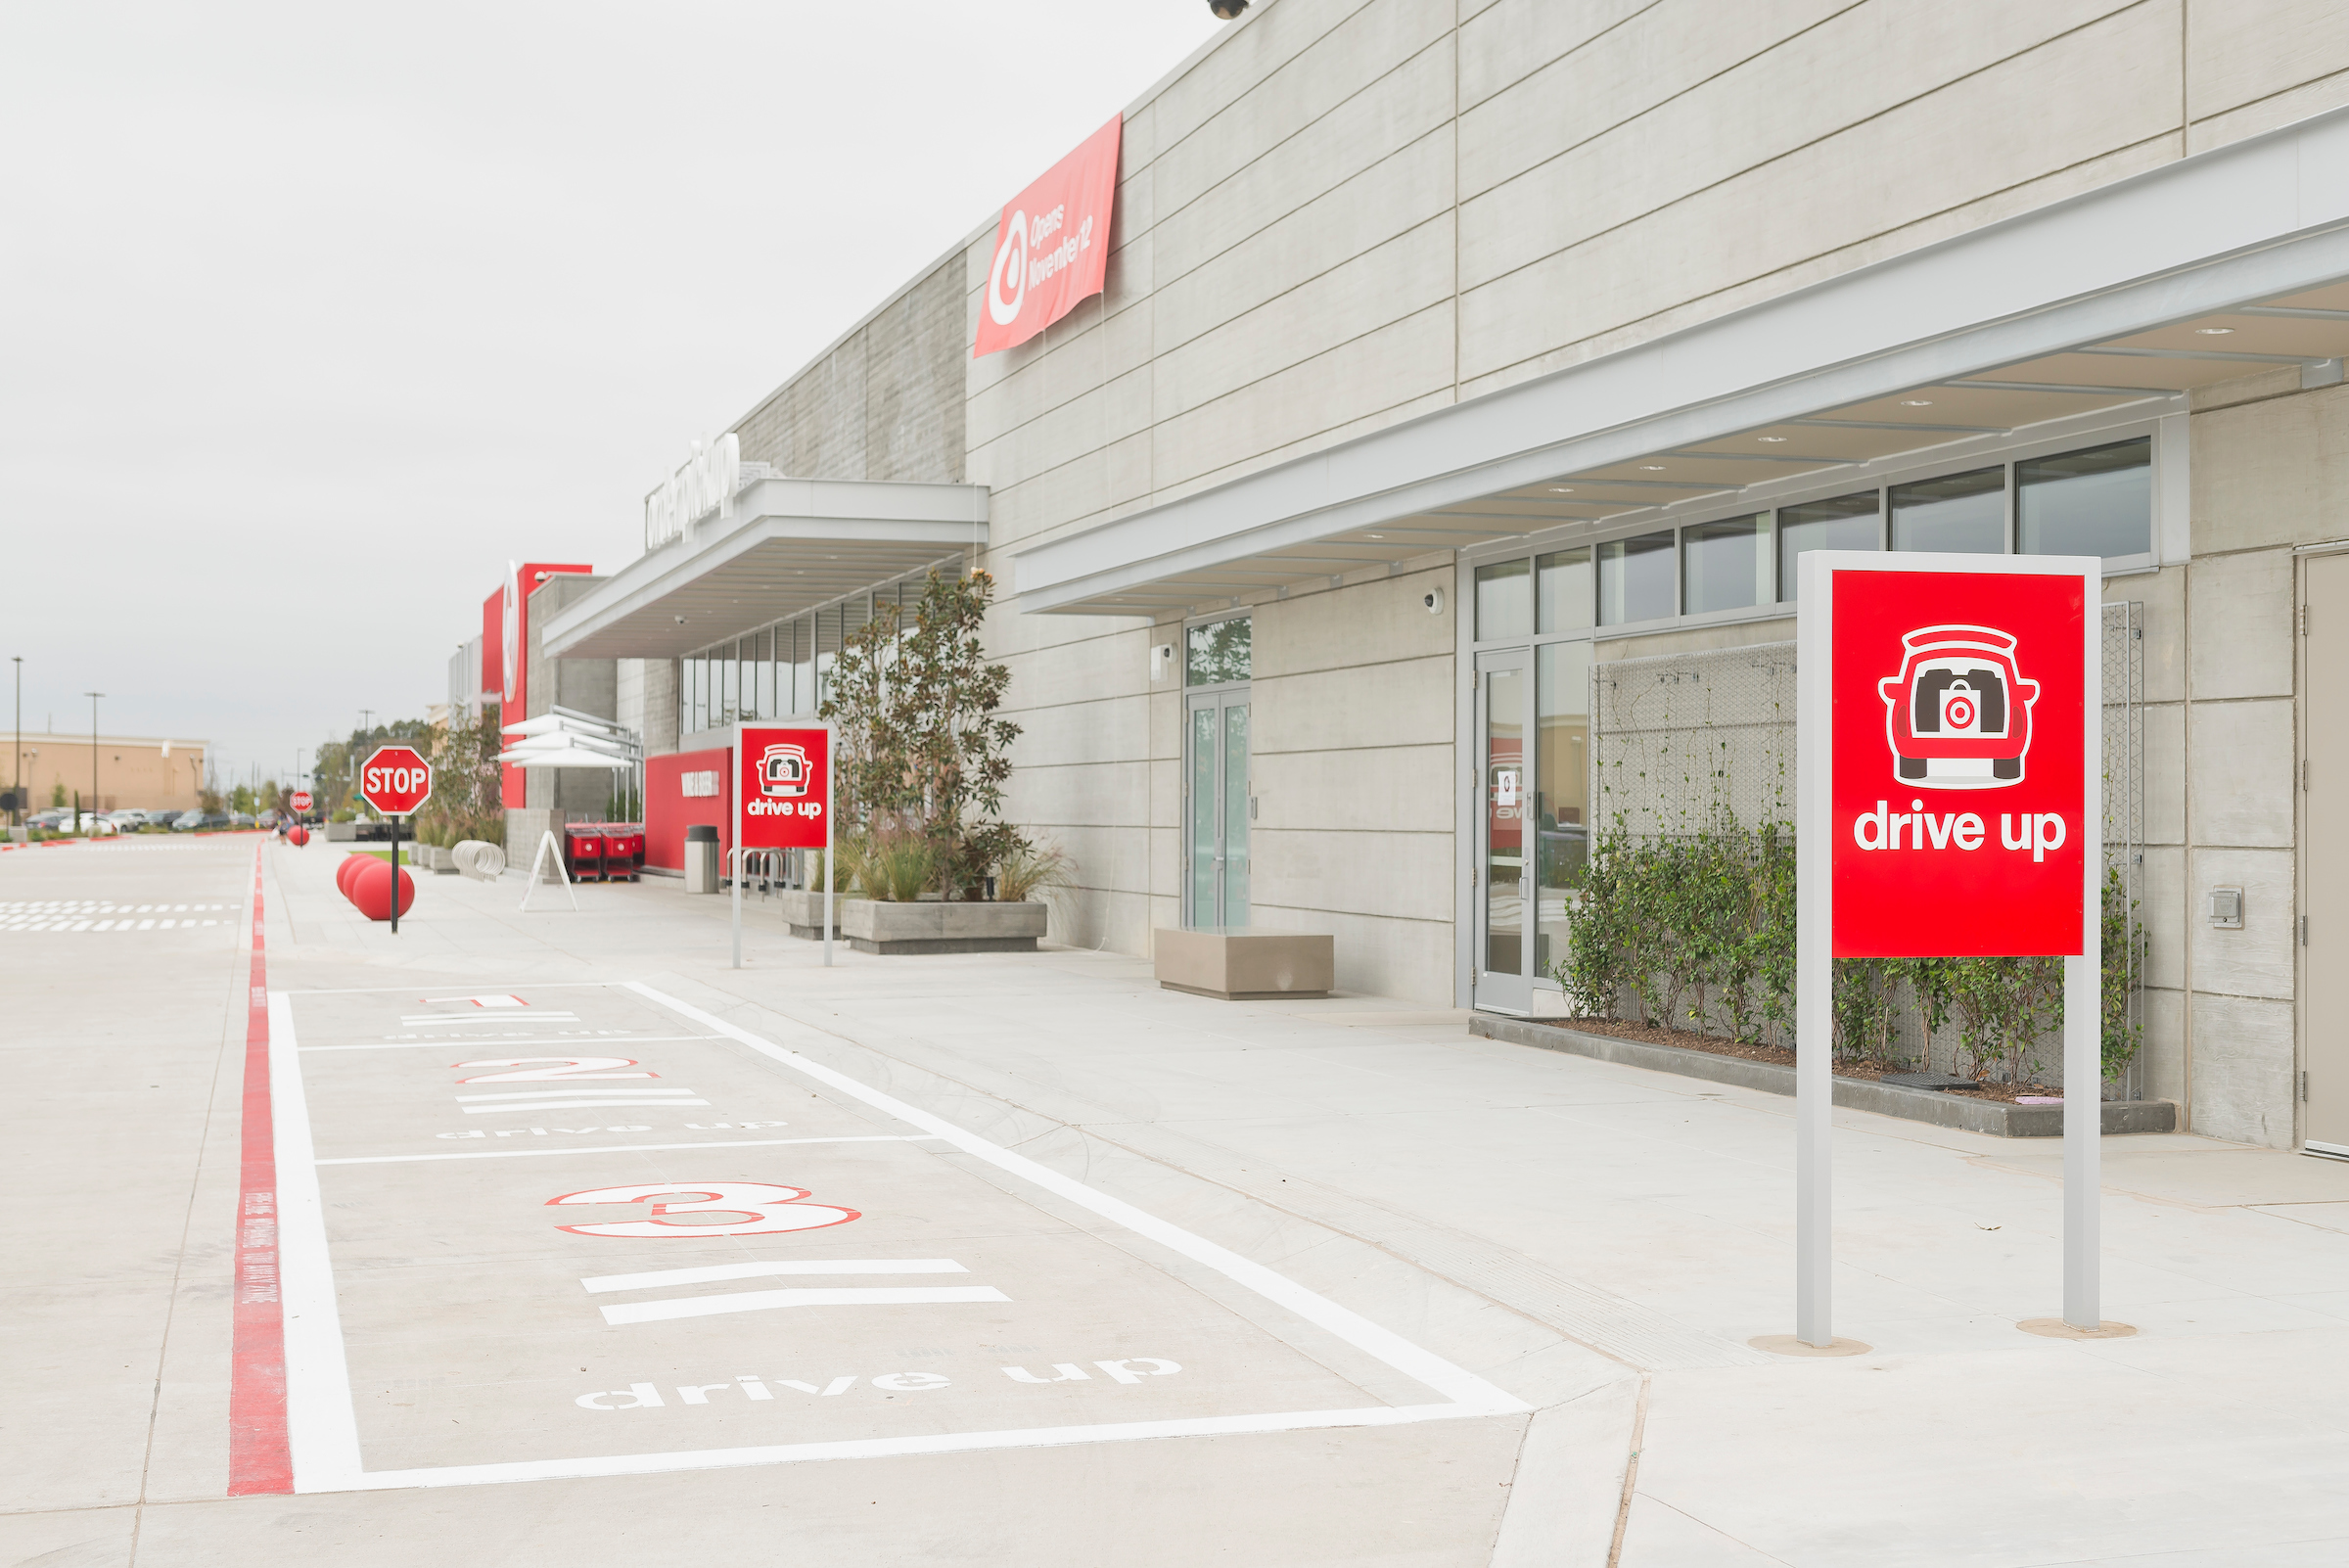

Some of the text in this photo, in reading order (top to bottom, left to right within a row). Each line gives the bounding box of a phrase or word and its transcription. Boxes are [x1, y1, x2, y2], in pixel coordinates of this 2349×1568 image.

[1031, 204, 1064, 250] Opens
[366, 766, 427, 794] STOP
[292, 796, 311, 807] STOP
[747, 798, 823, 820] drive up
[1853, 798, 2067, 863] drive up
[419, 994, 530, 1008] 1
[450, 1056, 663, 1084] 2
[436, 1121, 789, 1139] drive up
[544, 1181, 863, 1239] 3
[575, 1354, 1183, 1409] drive up
